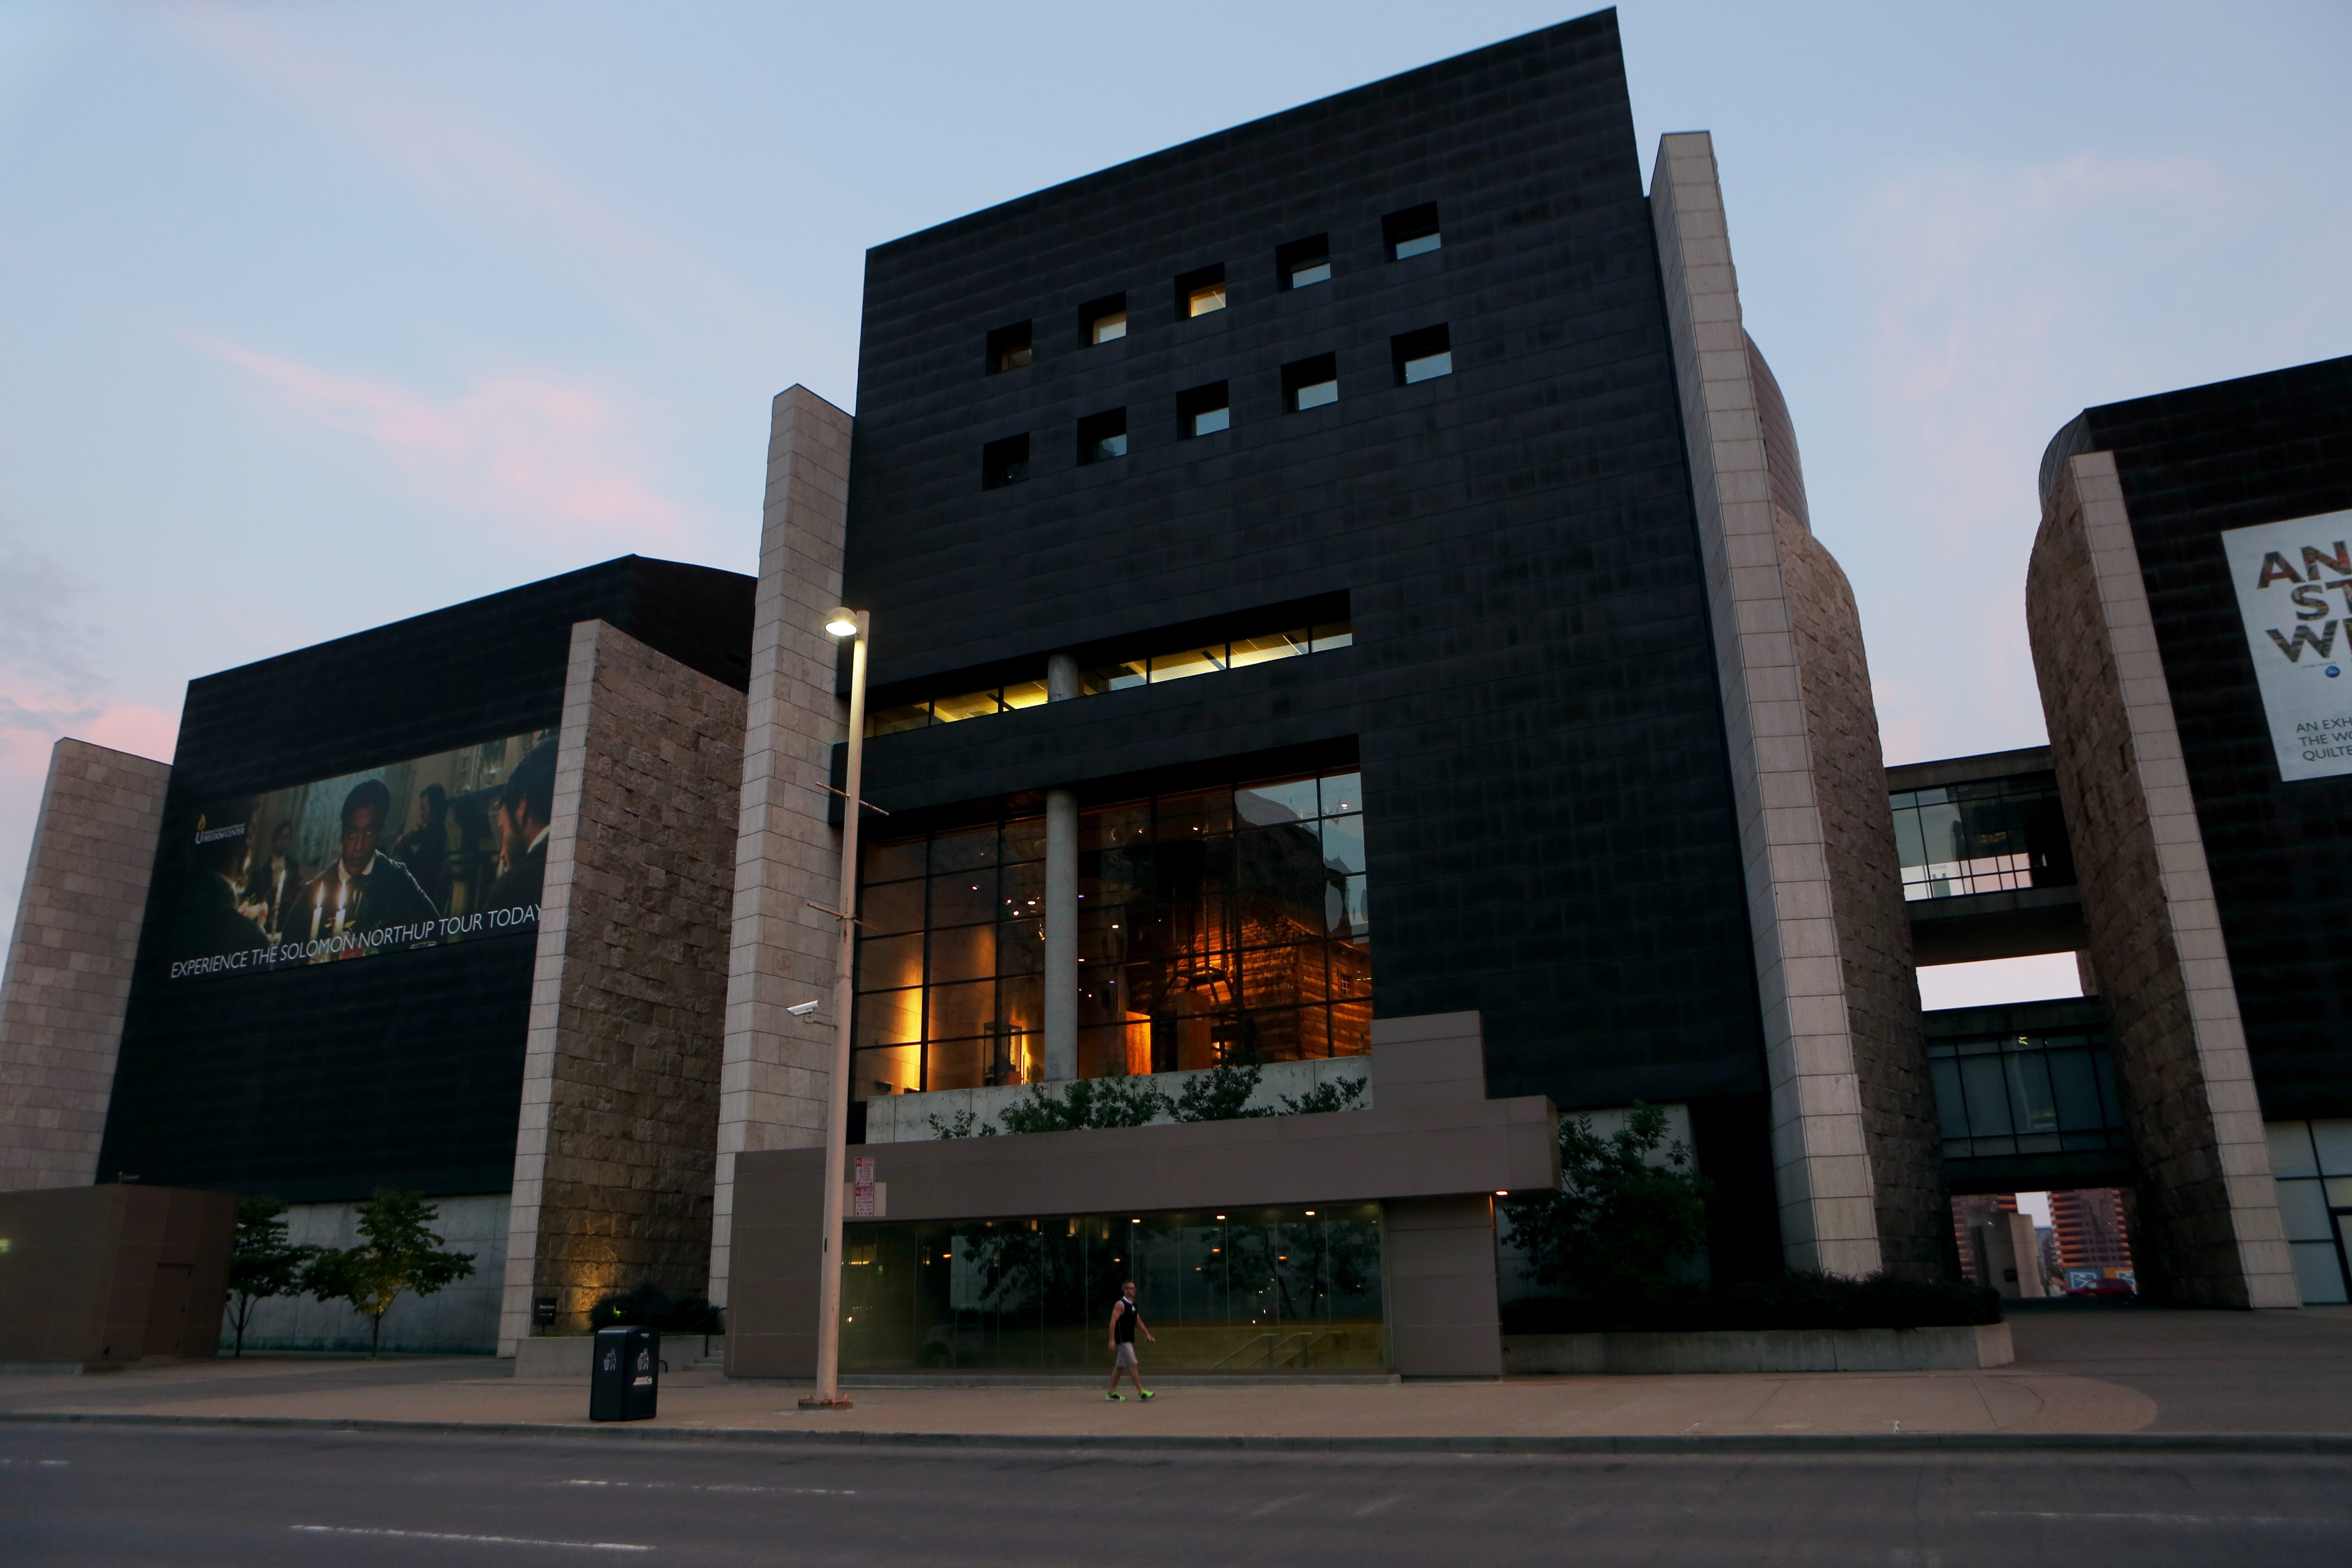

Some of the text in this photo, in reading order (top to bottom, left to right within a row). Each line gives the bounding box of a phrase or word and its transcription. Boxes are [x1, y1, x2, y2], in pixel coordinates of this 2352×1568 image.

[2257, 540, 2352, 589] AN
[2265, 617, 2352, 663] W
[2296, 716, 2352, 733] AN EXH
[2298, 734, 2328, 746] THE
[2303, 744, 2352, 762] QUILTE
[170, 904, 541, 978] EXPERIENCE THE SOLOMON NORTHUP TOUR TODAY
